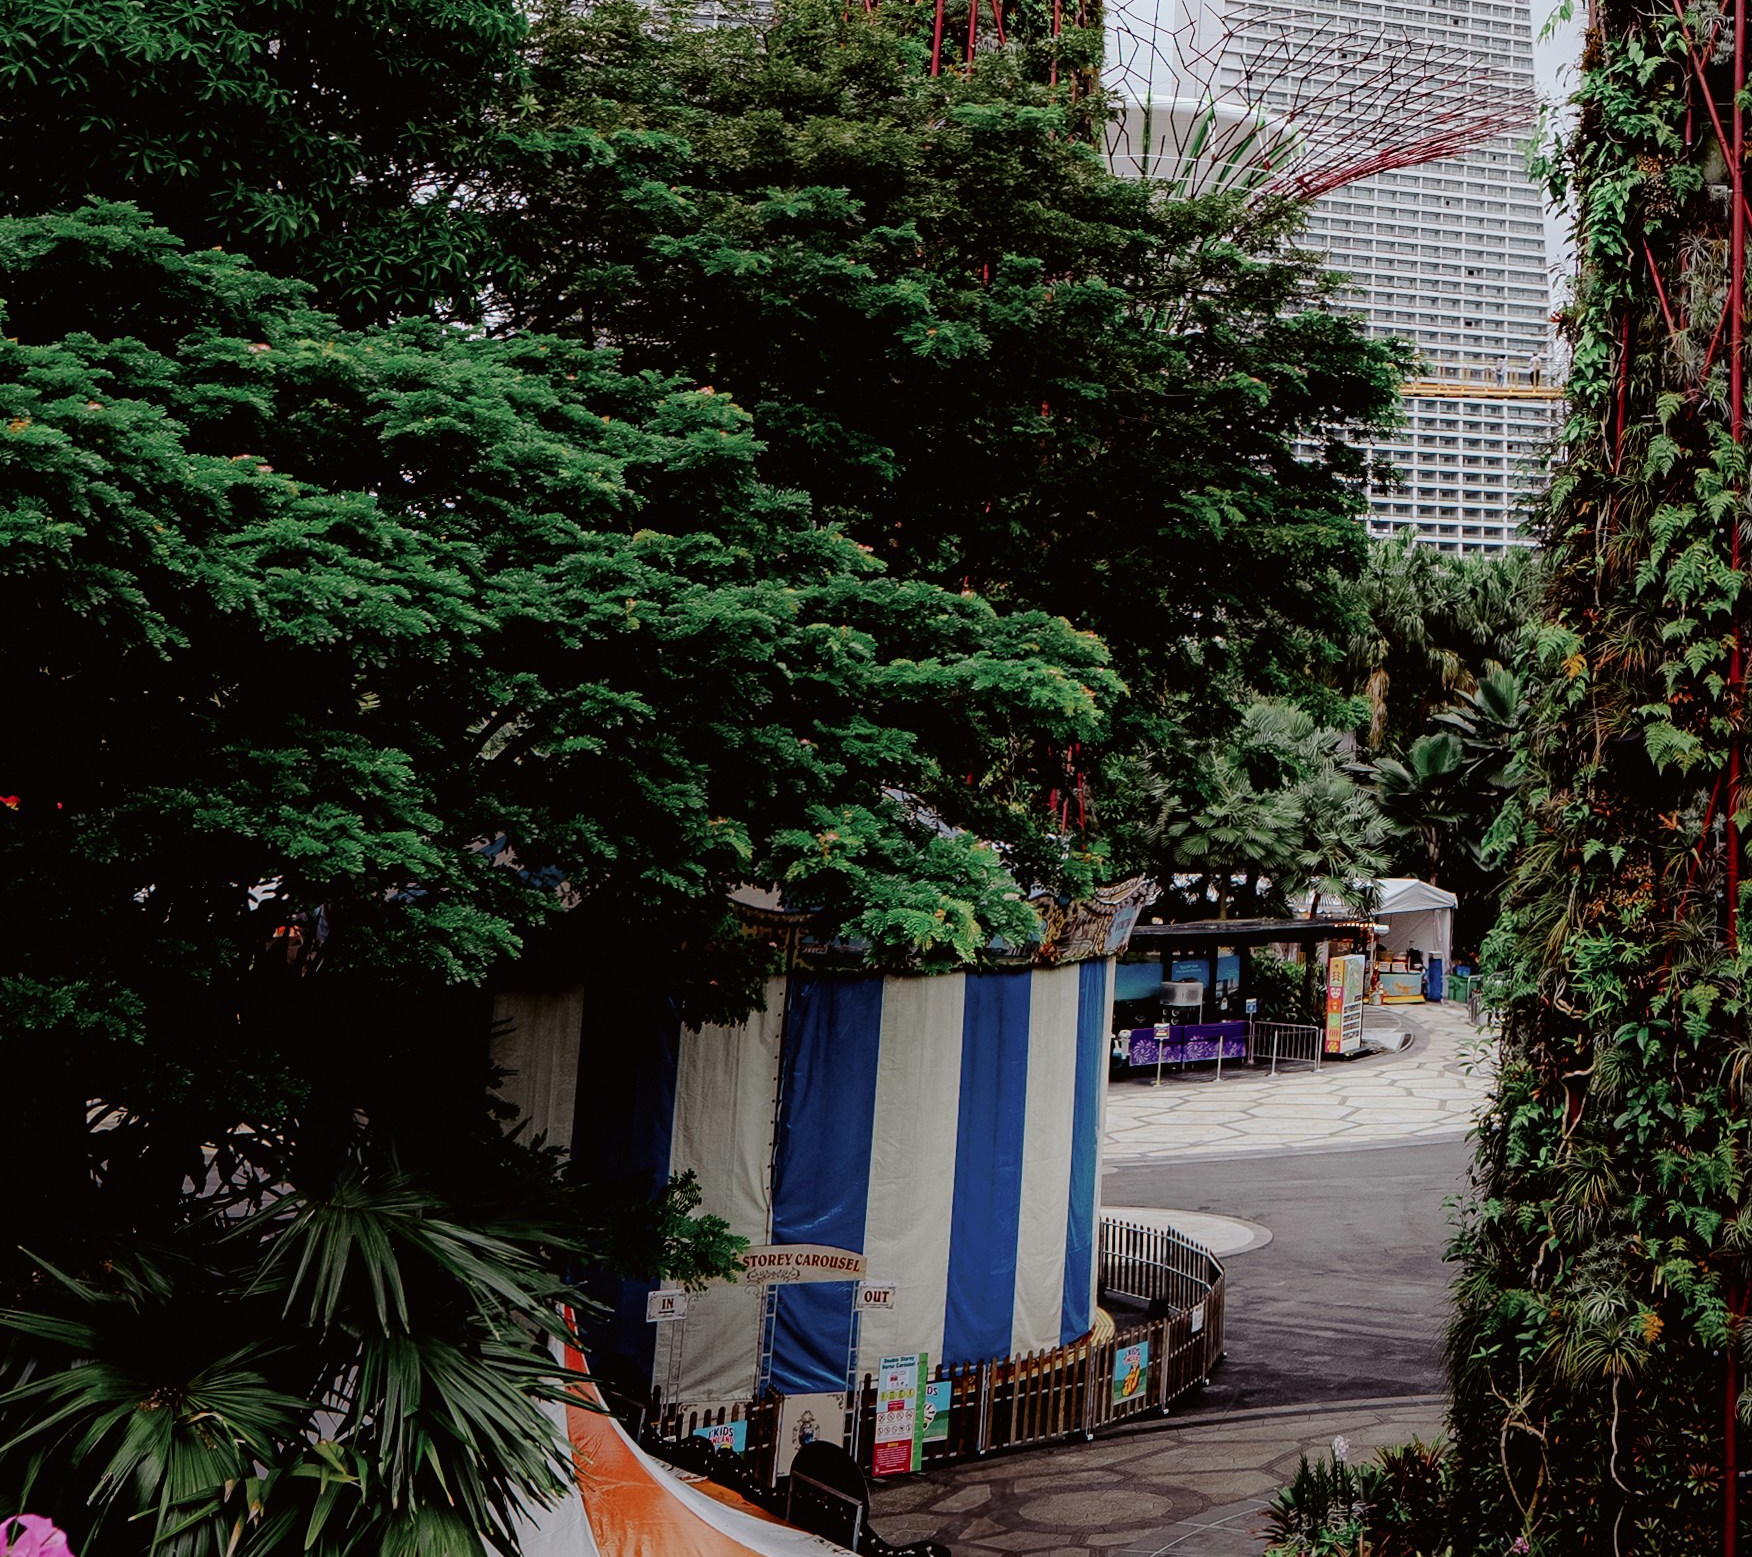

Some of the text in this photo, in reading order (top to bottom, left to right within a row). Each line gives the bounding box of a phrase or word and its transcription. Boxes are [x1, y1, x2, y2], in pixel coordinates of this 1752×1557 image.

[742, 1253, 860, 1272] STOREY CAROUSEL
[864, 1290, 889, 1303] OUT
[662, 1298, 674, 1309] IN
[927, 1386, 938, 1396] DS
